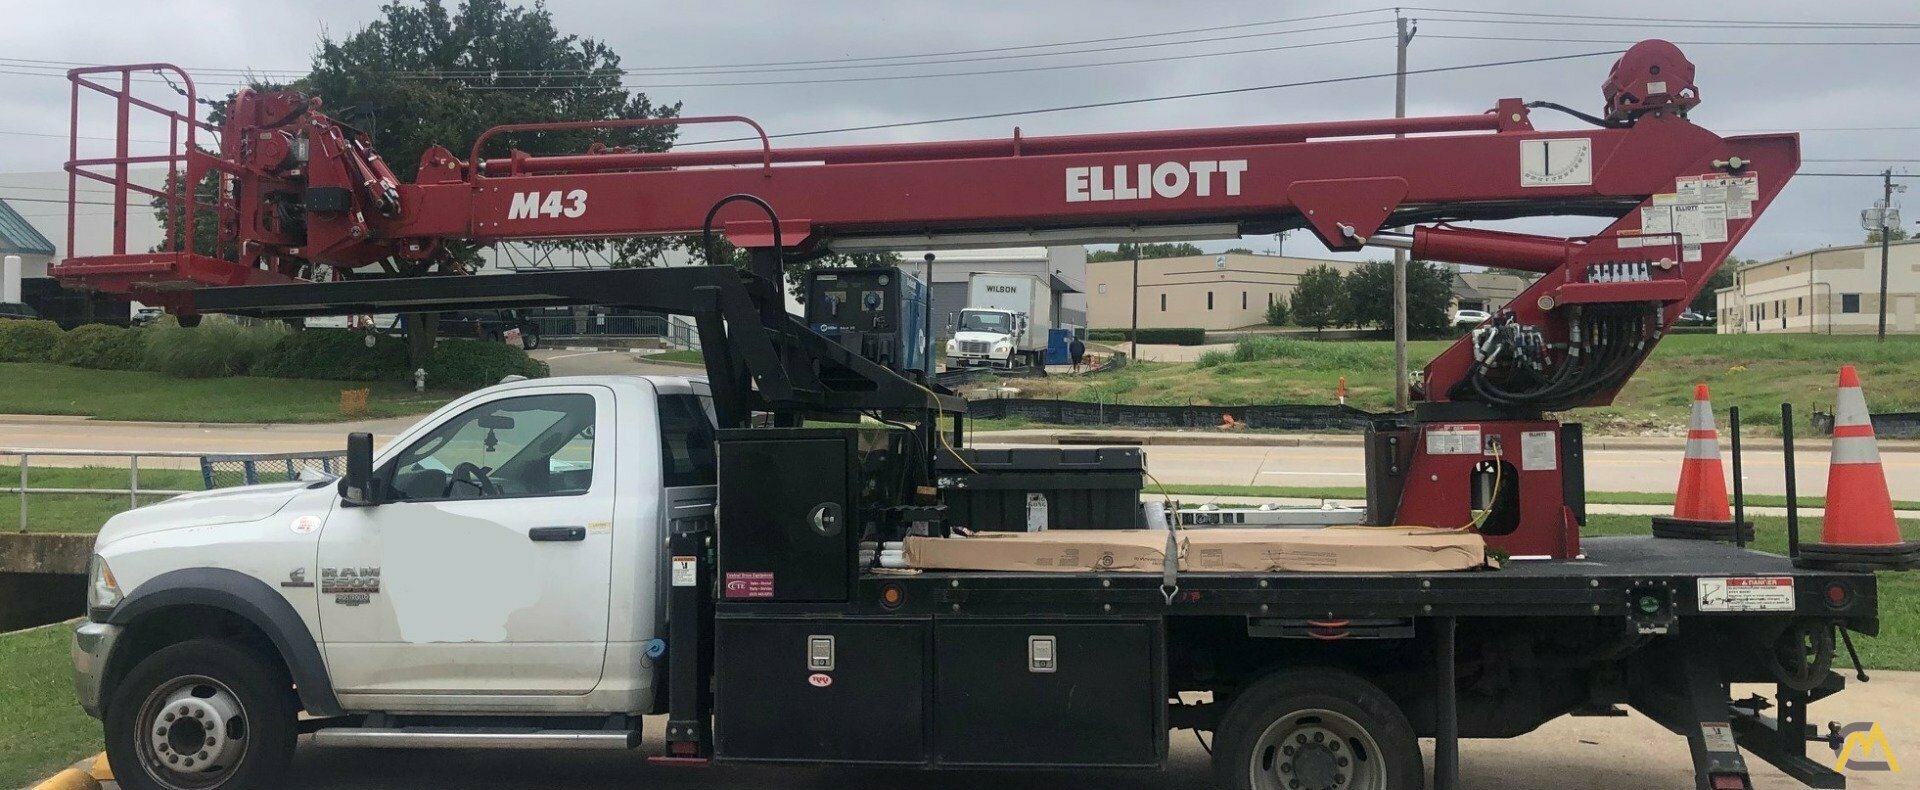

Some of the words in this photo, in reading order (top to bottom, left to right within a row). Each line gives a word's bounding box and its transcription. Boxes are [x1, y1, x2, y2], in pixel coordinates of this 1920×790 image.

[1066, 159, 1248, 202] ELLIOTT
[507, 189, 588, 220] M43
[1675, 204, 1699, 212] ELLIOTT
[986, 285, 1017, 294] WILSON
[322, 567, 380, 577] RAM
[322, 577, 380, 588] 5500
